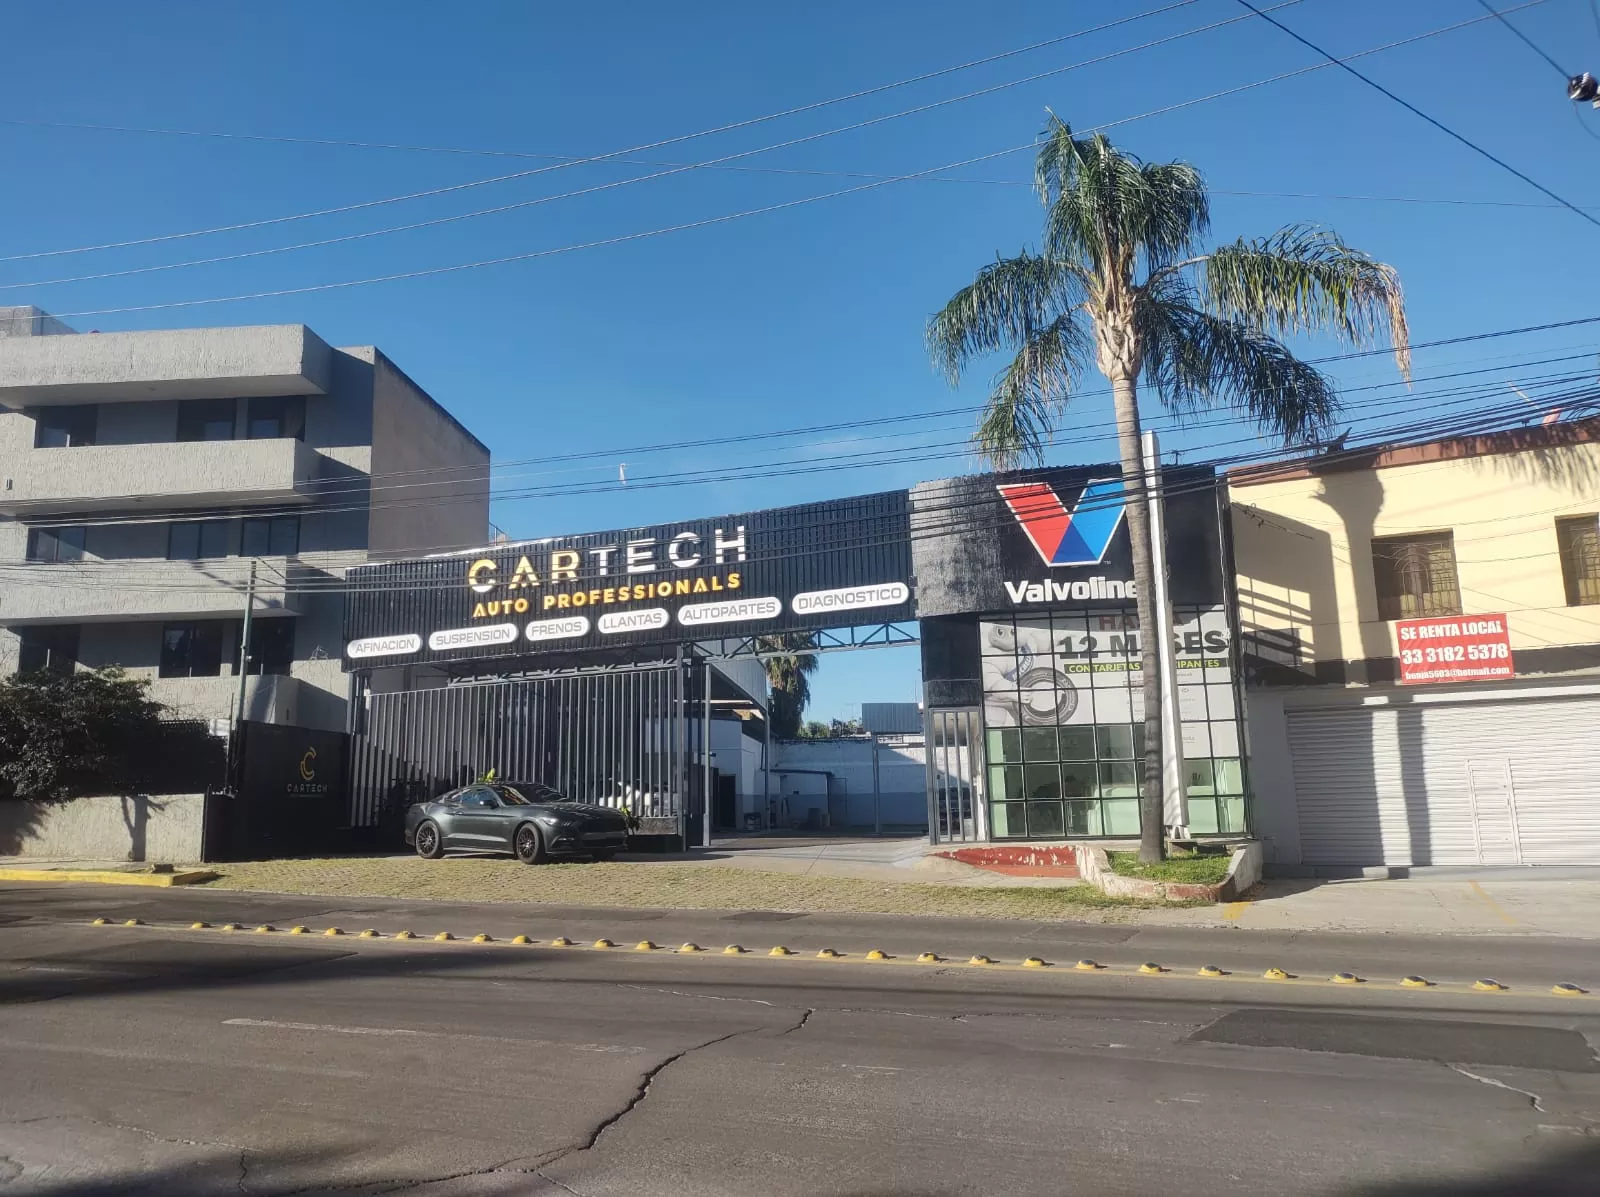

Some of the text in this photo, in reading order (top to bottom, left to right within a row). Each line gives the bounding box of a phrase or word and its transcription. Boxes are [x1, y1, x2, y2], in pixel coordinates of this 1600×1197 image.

[468, 525, 747, 593] CARTECH
[472, 572, 741, 618] AUTO PROFESSIONALS
[798, 587, 903, 609] DIAGNOSTICO
[1004, 576, 1137, 604] Valvoline
[603, 612, 662, 630] LLANTAS
[682, 602, 776, 621] AUTOPARTES
[436, 629, 510, 646] SUSPENSION
[531, 622, 582, 637] FRENOS
[1401, 620, 1503, 640] SE RENTA LOCAL
[355, 638, 415, 654] AFINACION
[1057, 635, 1098, 659] 12
[1402, 643, 1508, 665] 33 3182 5378
[1069, 665, 1091, 673] CON
[1093, 662, 1141, 672] TARJETAS
